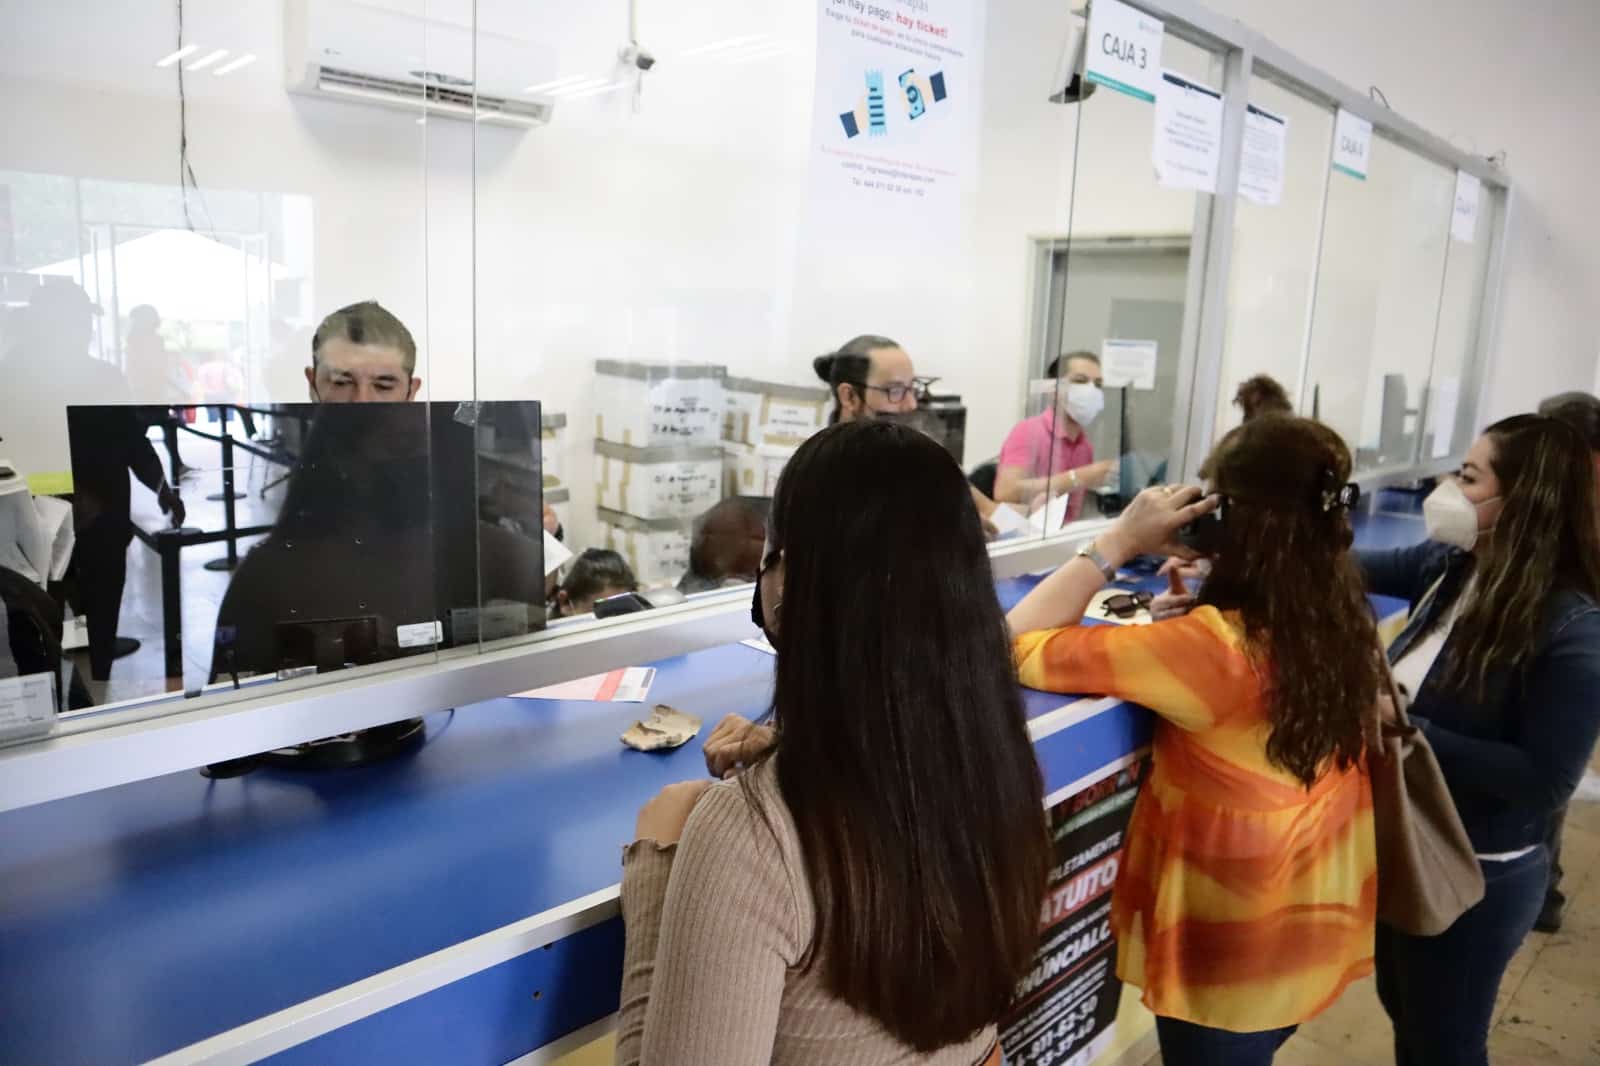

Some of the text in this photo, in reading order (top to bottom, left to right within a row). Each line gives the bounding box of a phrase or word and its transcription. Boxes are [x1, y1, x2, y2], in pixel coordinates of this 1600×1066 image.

[896, 11, 914, 29] hay
[916, 20, 948, 38] ticket!
[1102, 32, 1147, 69] CAJA 3
[1049, 831, 1121, 882] PLETAMENTE
[1040, 857, 1119, 924] ATUITO
